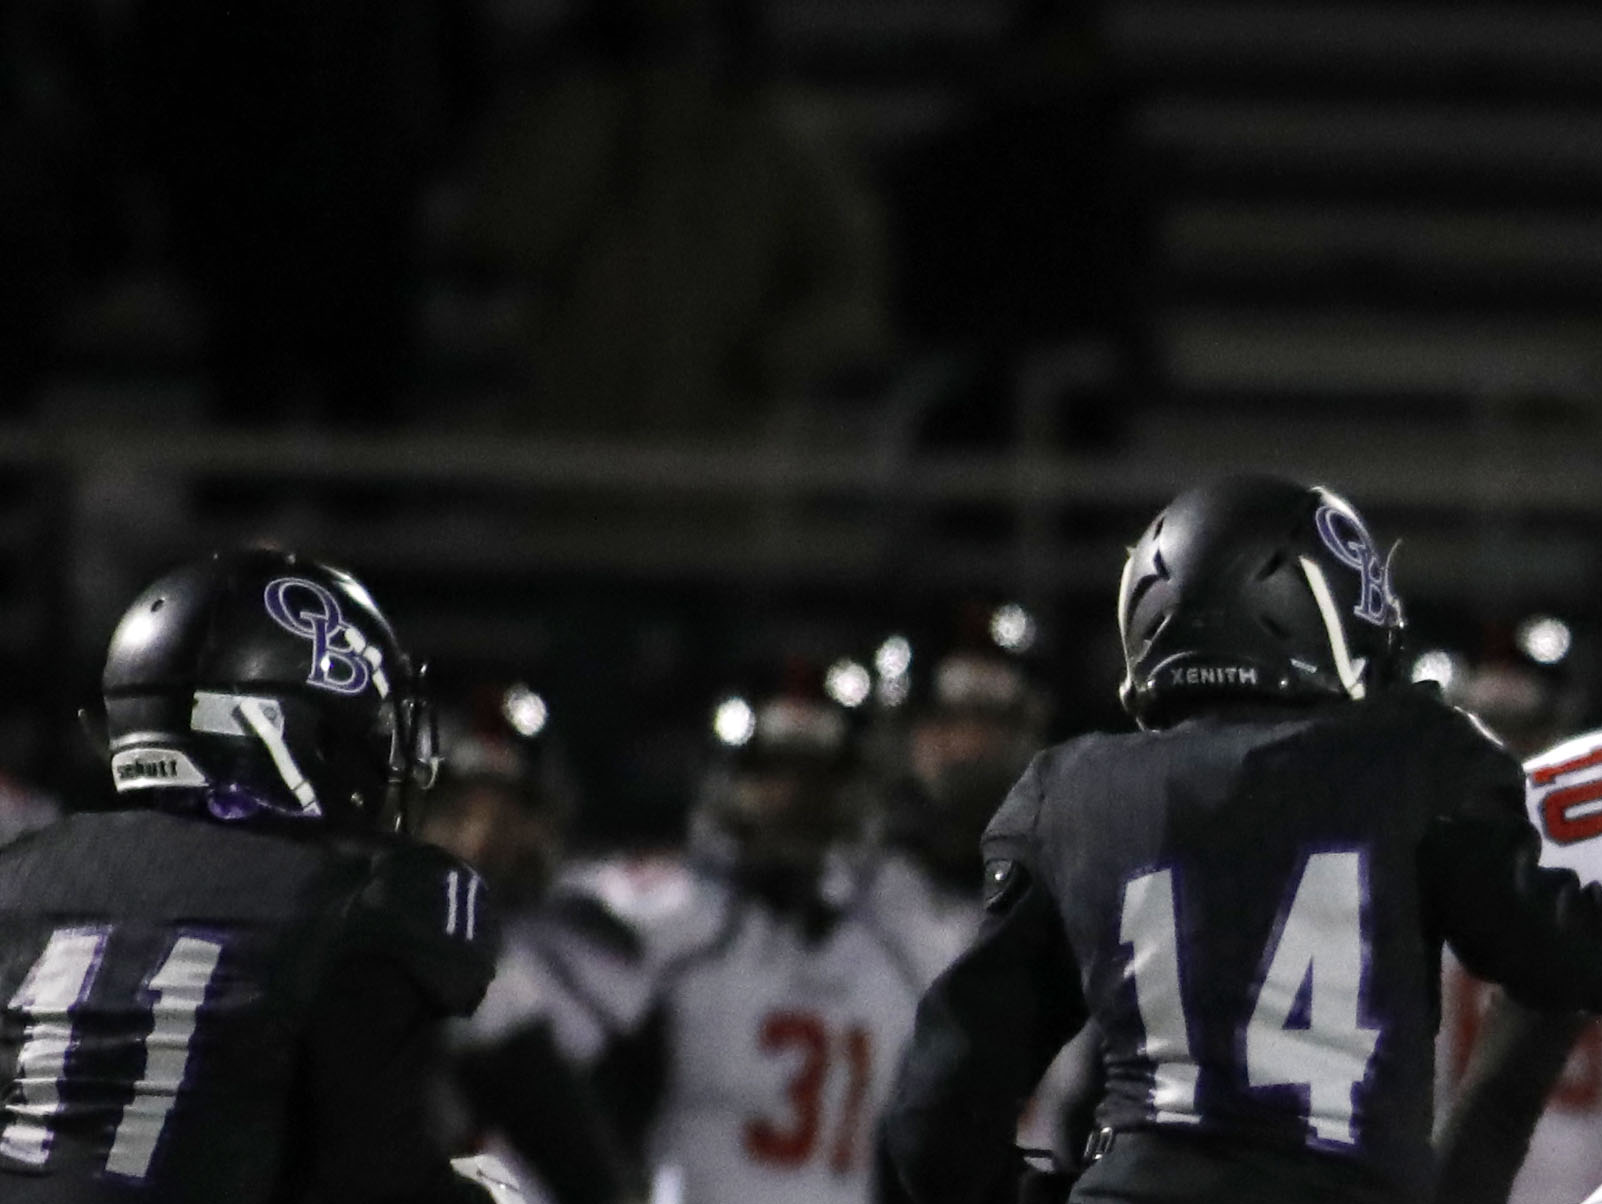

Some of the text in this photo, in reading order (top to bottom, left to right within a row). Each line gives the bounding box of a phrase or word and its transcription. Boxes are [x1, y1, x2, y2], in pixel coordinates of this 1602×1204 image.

[1170, 665, 1257, 686] XENITH
[444, 868, 483, 942] 11
[0, 926, 224, 1182] 11
[1114, 847, 1385, 1149] 14
[738, 1006, 876, 1172] 31
